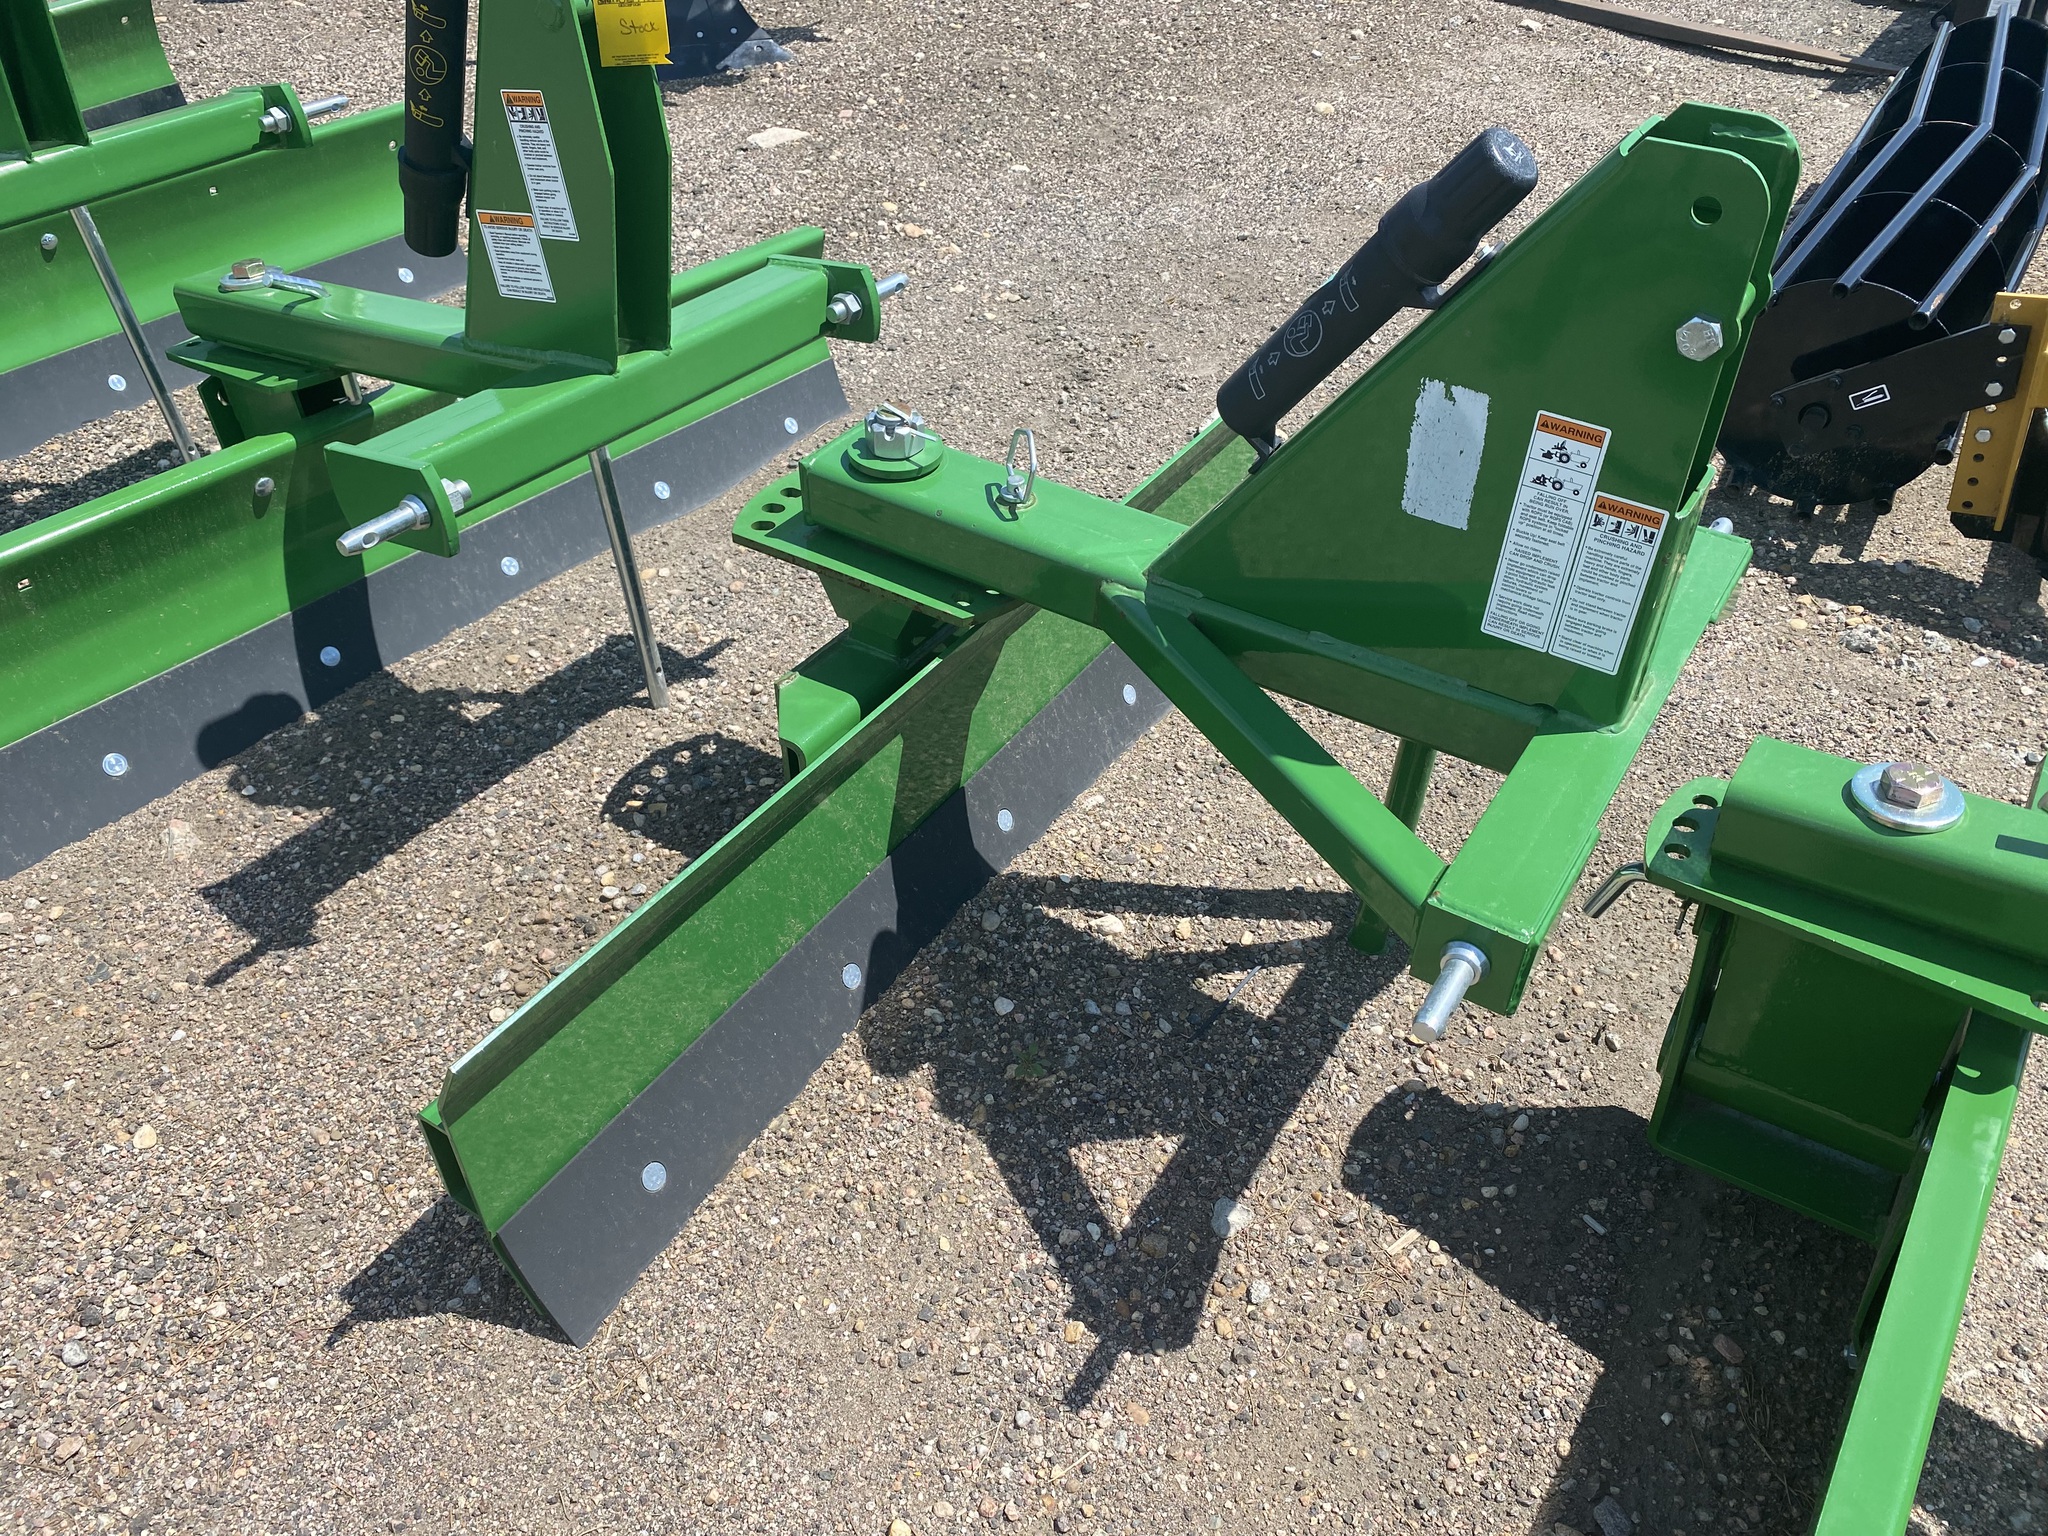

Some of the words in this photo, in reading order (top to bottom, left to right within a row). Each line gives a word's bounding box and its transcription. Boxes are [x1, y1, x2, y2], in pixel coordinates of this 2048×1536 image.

[620, 18, 659, 35] Stock
[512, 95, 540, 104] WARNING
[494, 216, 524, 224] WARNING
[1550, 421, 1602, 443] WARNING
[1537, 492, 1556, 500] FALLING
[1608, 503, 1660, 524] WARNING
[1600, 534, 1629, 546] CRUSHING
[1594, 537, 1621, 549] PINCHING
[1621, 546, 1645, 556] HAZARD
[1594, 548, 1613, 557] extremely
[1532, 553, 1558, 564] IMPLEMENT
[1490, 611, 1508, 620] FALLING
[1489, 615, 1518, 627] UNDERNEATH
[1519, 625, 1544, 635] IMPLEMENT
[1521, 630, 1540, 638] SERIOUS
